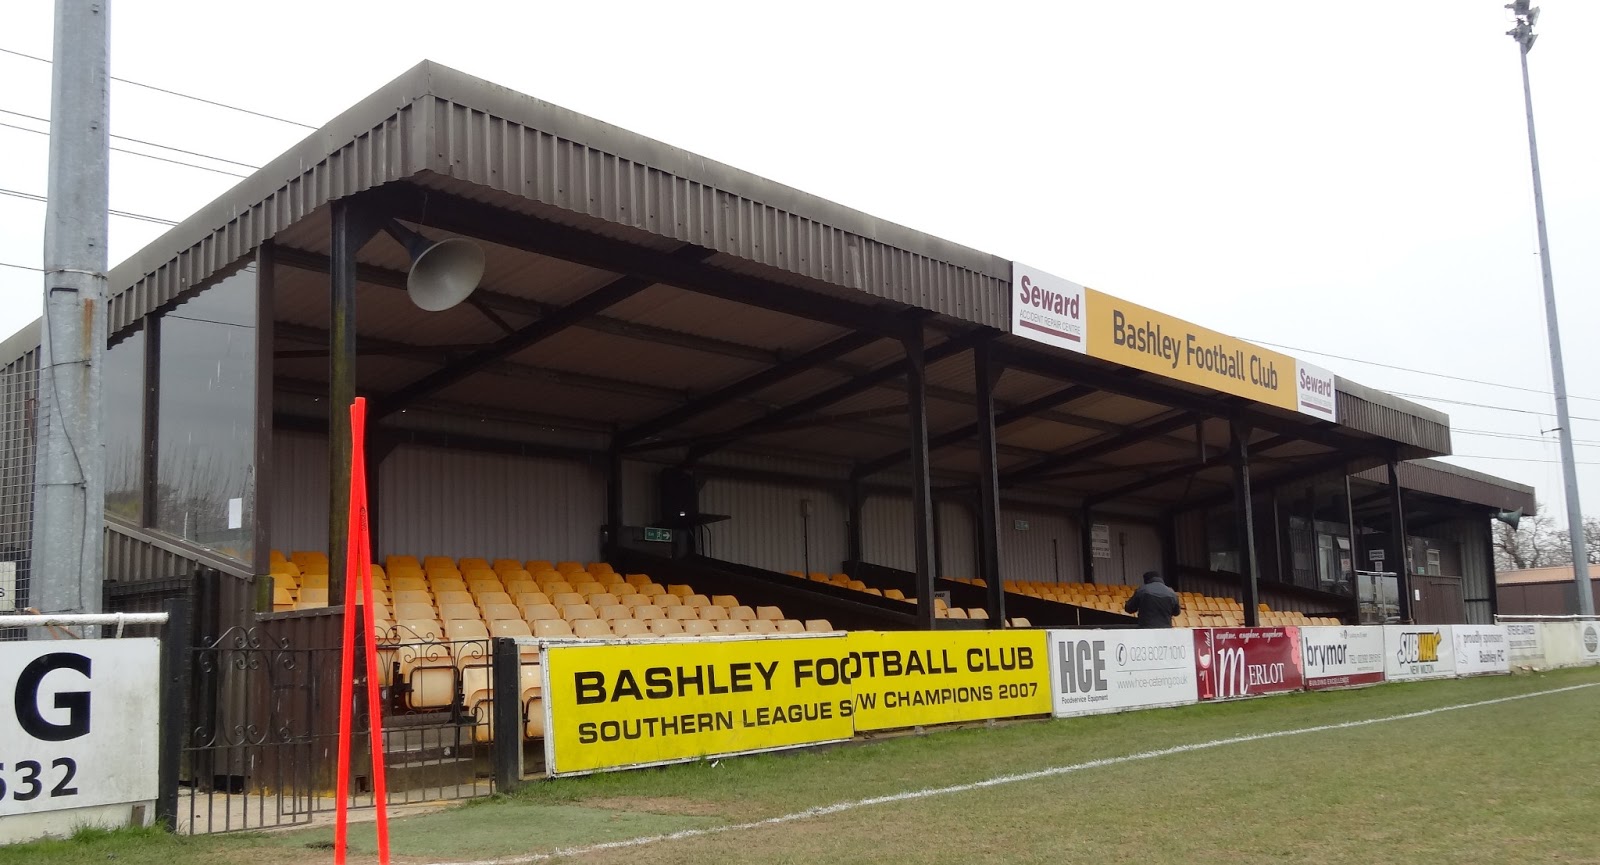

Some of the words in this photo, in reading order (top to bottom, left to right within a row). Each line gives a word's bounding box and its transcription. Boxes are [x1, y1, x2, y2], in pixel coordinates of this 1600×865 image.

[1020, 275, 1080, 320] Seward
[1020, 309, 1043, 323] ACCIDENT
[1044, 316, 1062, 330] REPAIR
[1062, 322, 1081, 335] CENTRE
[1113, 309, 1181, 369] Bashley
[1186, 333, 1246, 381] Football
[1250, 354, 1278, 391] Club
[1300, 368, 1331, 398] Seward
[1058, 640, 1108, 693] HCE
[1130, 646, 1147, 661] 023
[1305, 637, 1347, 673] brymor
[1397, 627, 1442, 668] SUBWAY
[574, 661, 779, 705] BASHLEY
[794, 649, 957, 688] FOOTBALL
[967, 647, 1034, 673] CLUB
[1410, 665, 1420, 675] NEW
[14, 652, 92, 742] G
[578, 710, 733, 744] SOUTHERN
[742, 700, 833, 728] LEAGUE
[840, 692, 877, 717] S/W
[884, 685, 993, 709] CHAMPIONS
[999, 682, 1039, 700] 2007
[1061, 696, 1086, 704] Foodservice
[1088, 694, 1109, 703] Equipment
[0, 757, 78, 802] 32
